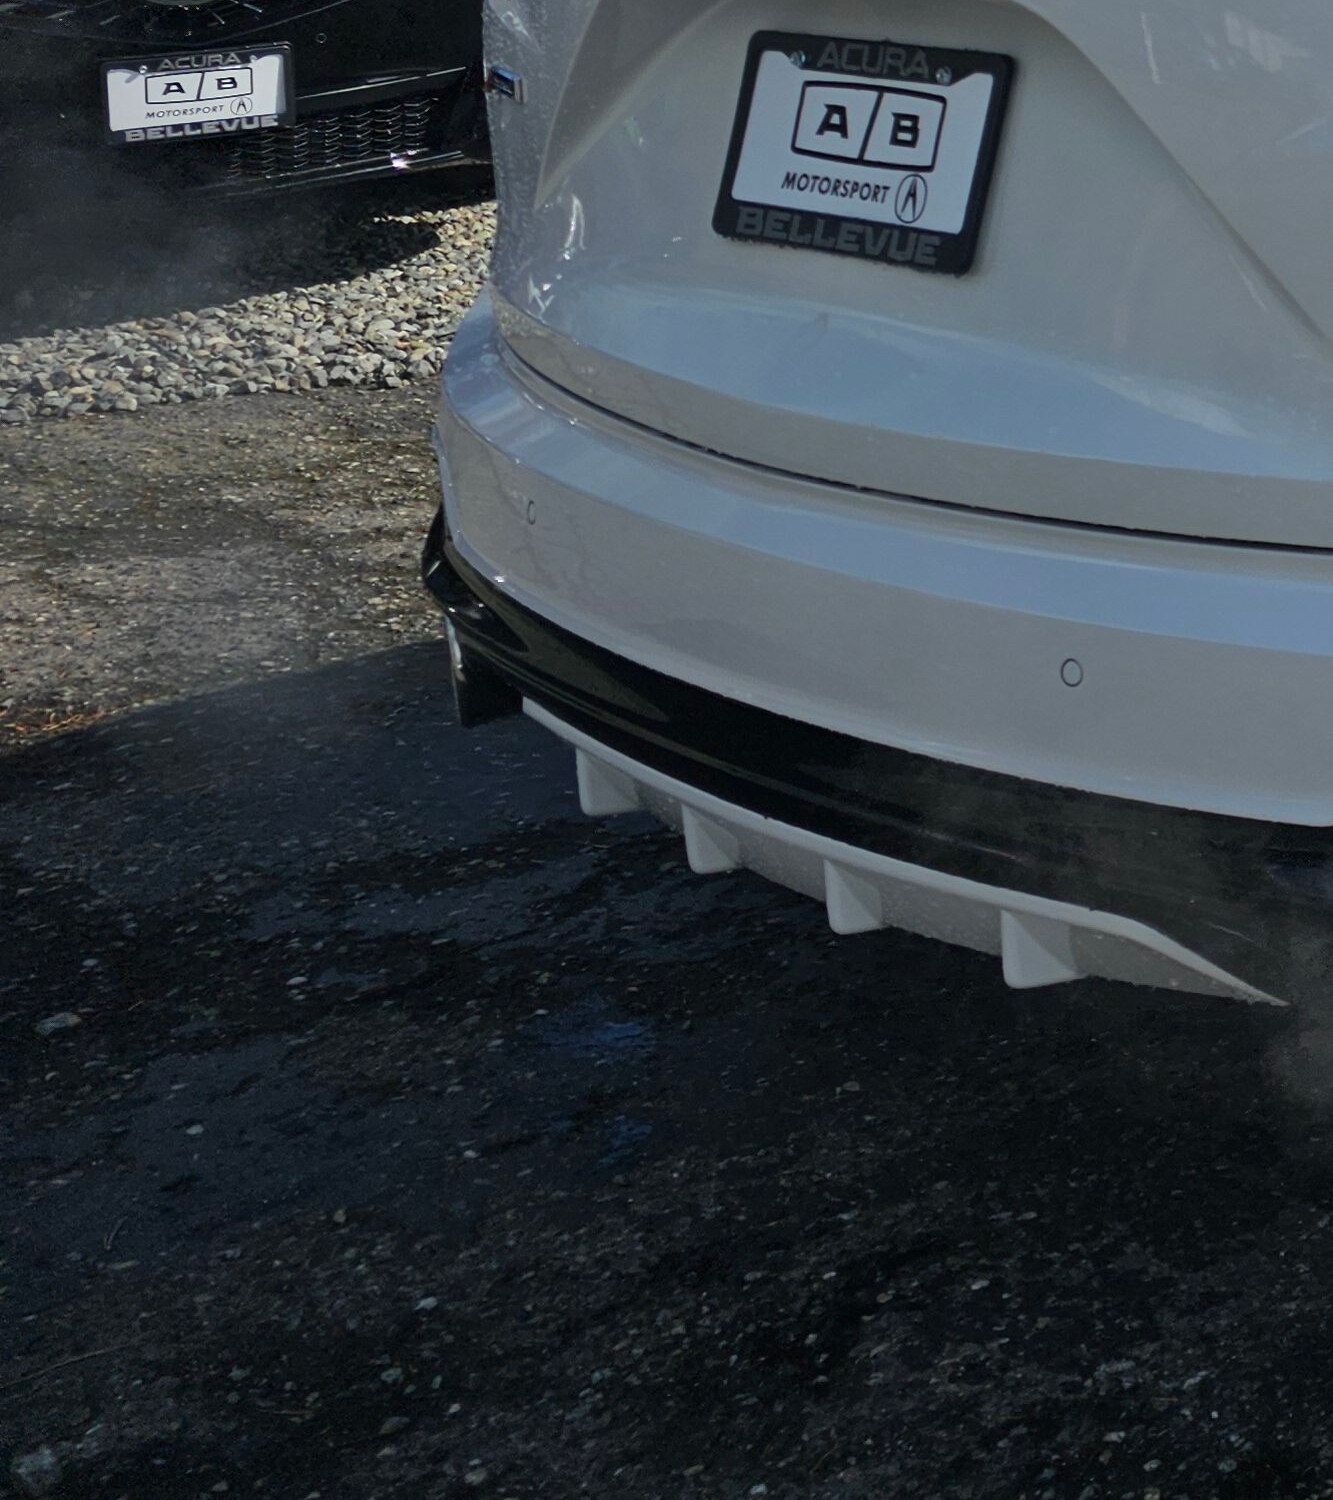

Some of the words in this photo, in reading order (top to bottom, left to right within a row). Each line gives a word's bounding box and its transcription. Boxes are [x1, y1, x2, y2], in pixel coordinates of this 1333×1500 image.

[157, 52, 241, 71] ACURA
[817, 41, 929, 79] ACURA
[162, 82, 185, 96] A
[216, 77, 238, 90] B
[145, 105, 225, 119] MOTORSPORT
[815, 104, 848, 140] A
[889, 112, 920, 148] B
[124, 114, 279, 143] BELLEVUE
[781, 171, 890, 204] MOTORSPORT
[735, 206, 941, 266] BELLEVUE
